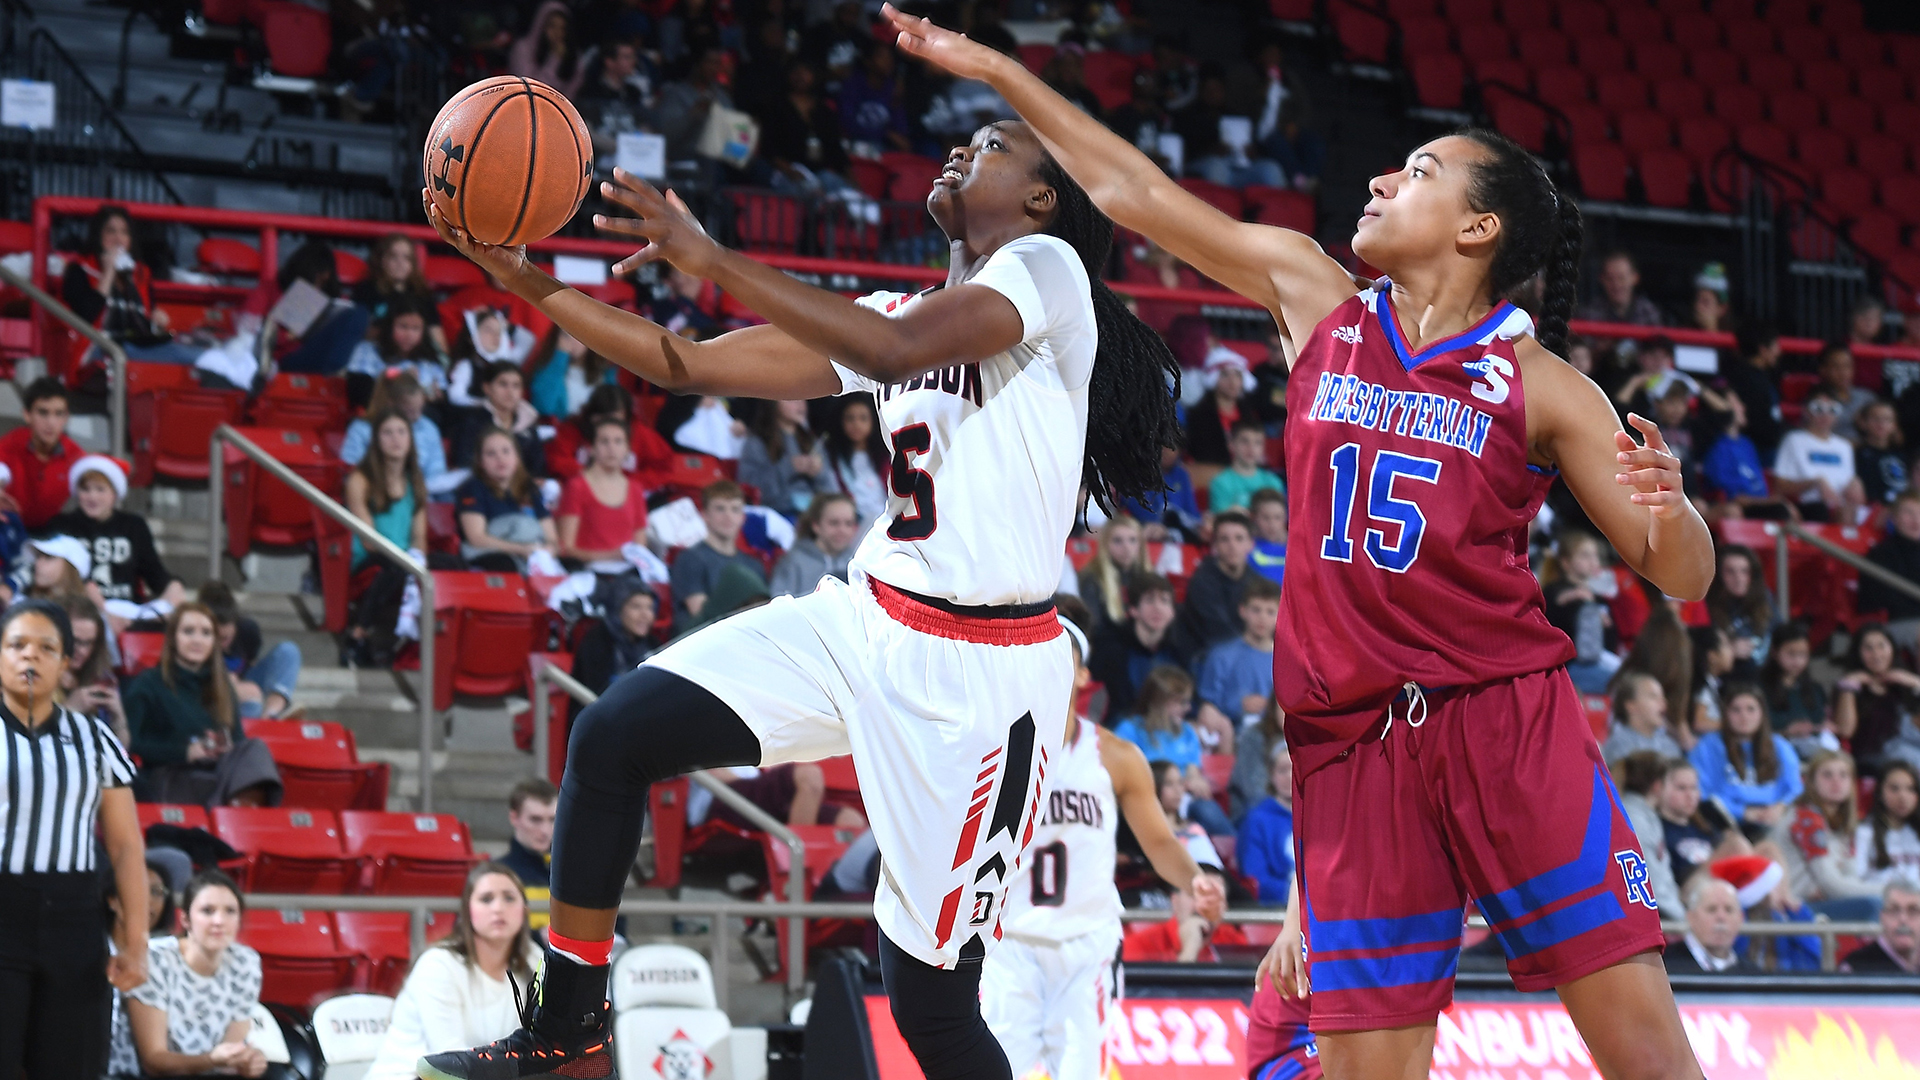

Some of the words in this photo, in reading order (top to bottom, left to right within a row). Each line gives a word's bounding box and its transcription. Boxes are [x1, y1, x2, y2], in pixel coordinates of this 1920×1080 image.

[1308, 371, 1493, 458] PRESBYTERIAN
[886, 421, 939, 542] 5
[1320, 442, 1442, 574] 15
[81, 537, 131, 563] SD
[1030, 840, 1068, 908] 0
[330, 1017, 391, 1035] DAVIDS
[1434, 1010, 1592, 1067] NBUR
